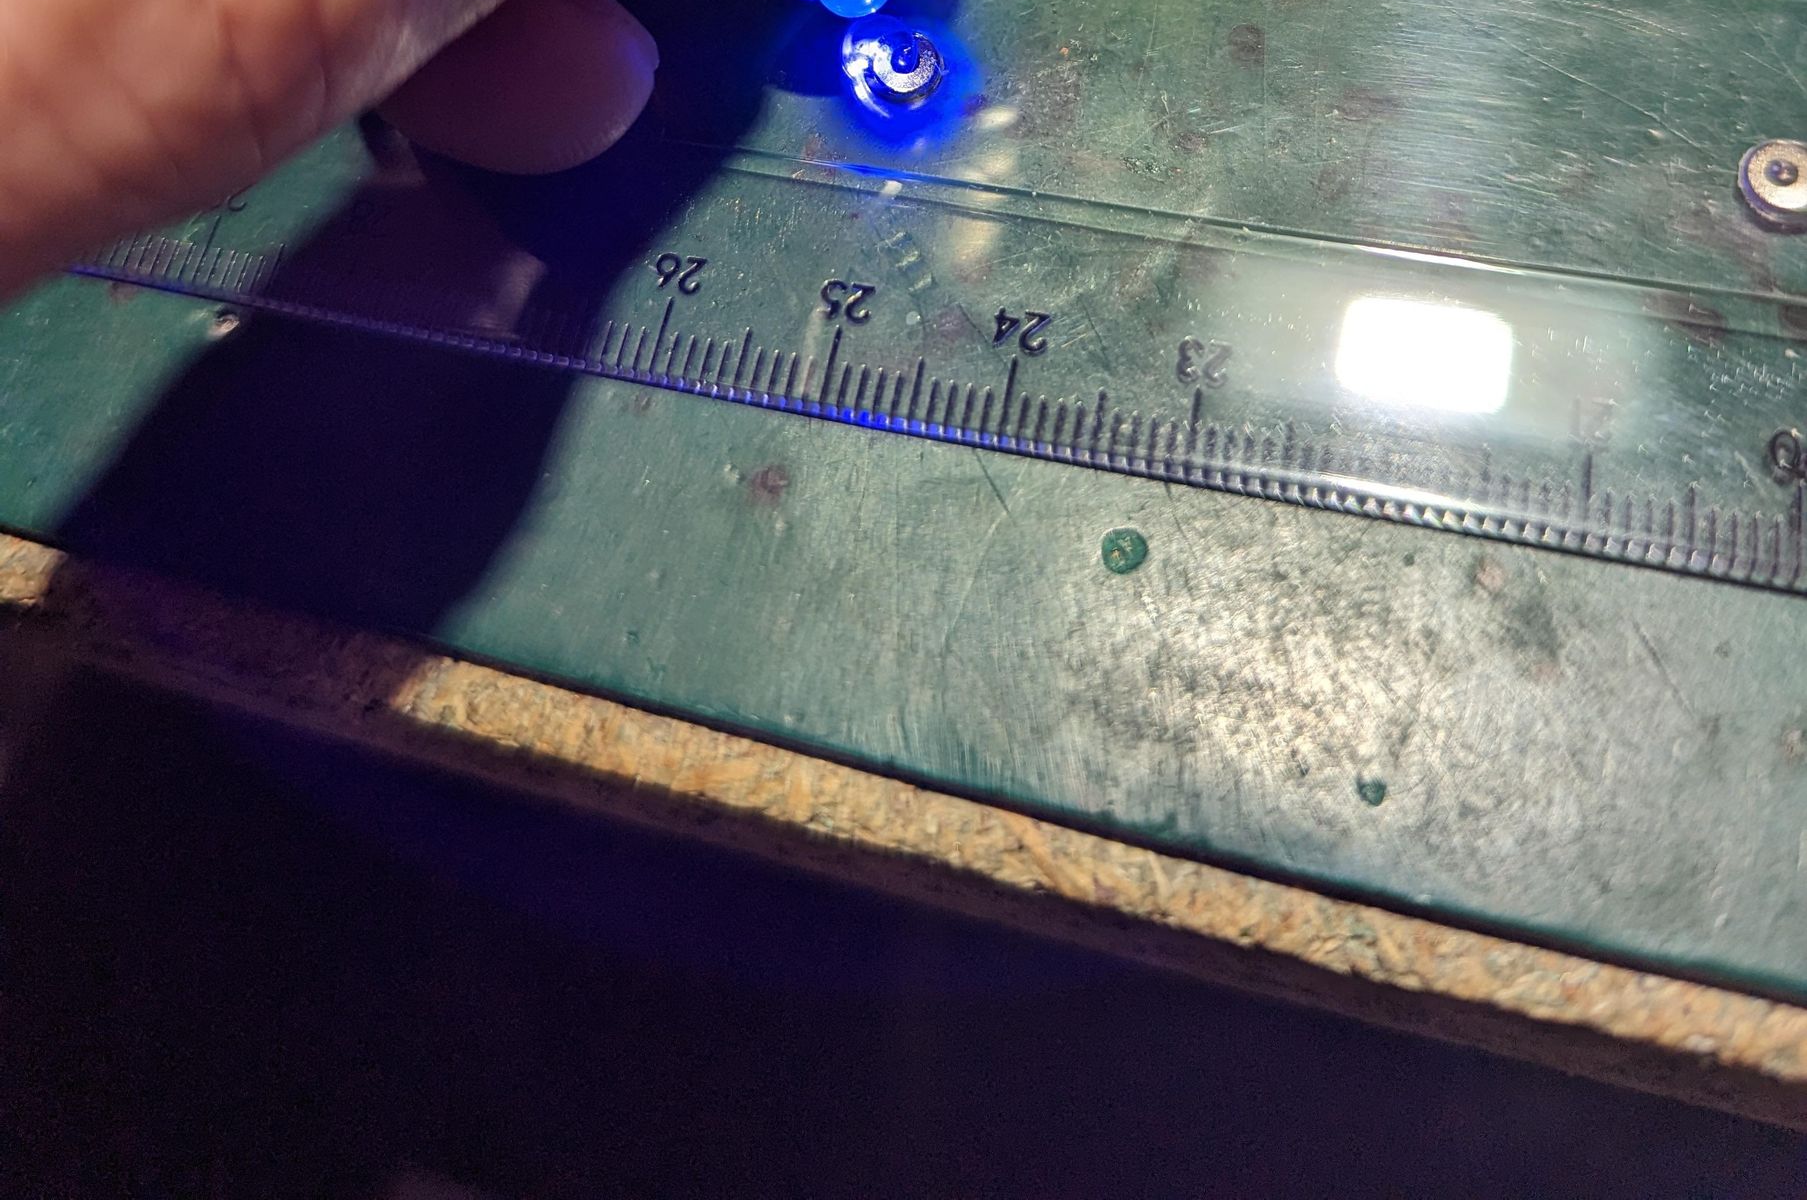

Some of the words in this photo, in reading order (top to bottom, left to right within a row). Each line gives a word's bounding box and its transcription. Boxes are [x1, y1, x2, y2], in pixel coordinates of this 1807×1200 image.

[656, 251, 707, 295] 26
[820, 278, 876, 324] 25
[992, 307, 1052, 355] 24
[1177, 336, 1234, 388] 23
